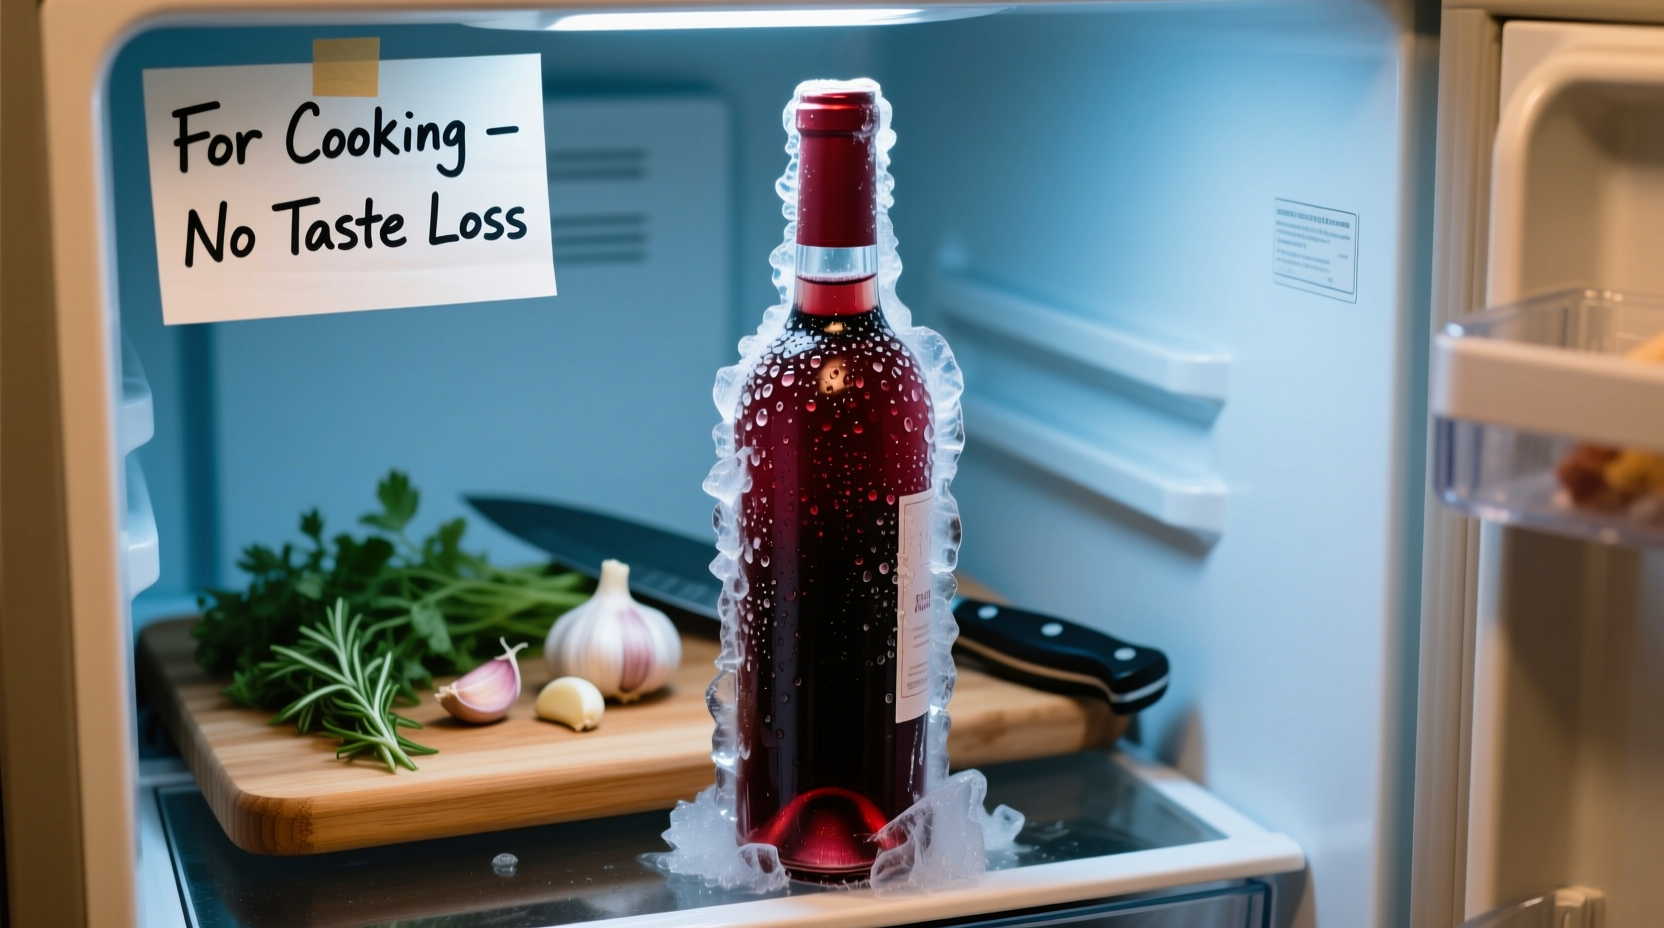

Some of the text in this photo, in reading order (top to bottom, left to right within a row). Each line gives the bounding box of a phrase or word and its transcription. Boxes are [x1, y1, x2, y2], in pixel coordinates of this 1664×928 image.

[171, 100, 263, 174] For
[285, 100, 466, 178] Cooking
[184, 191, 527, 268] No Taste Loss
